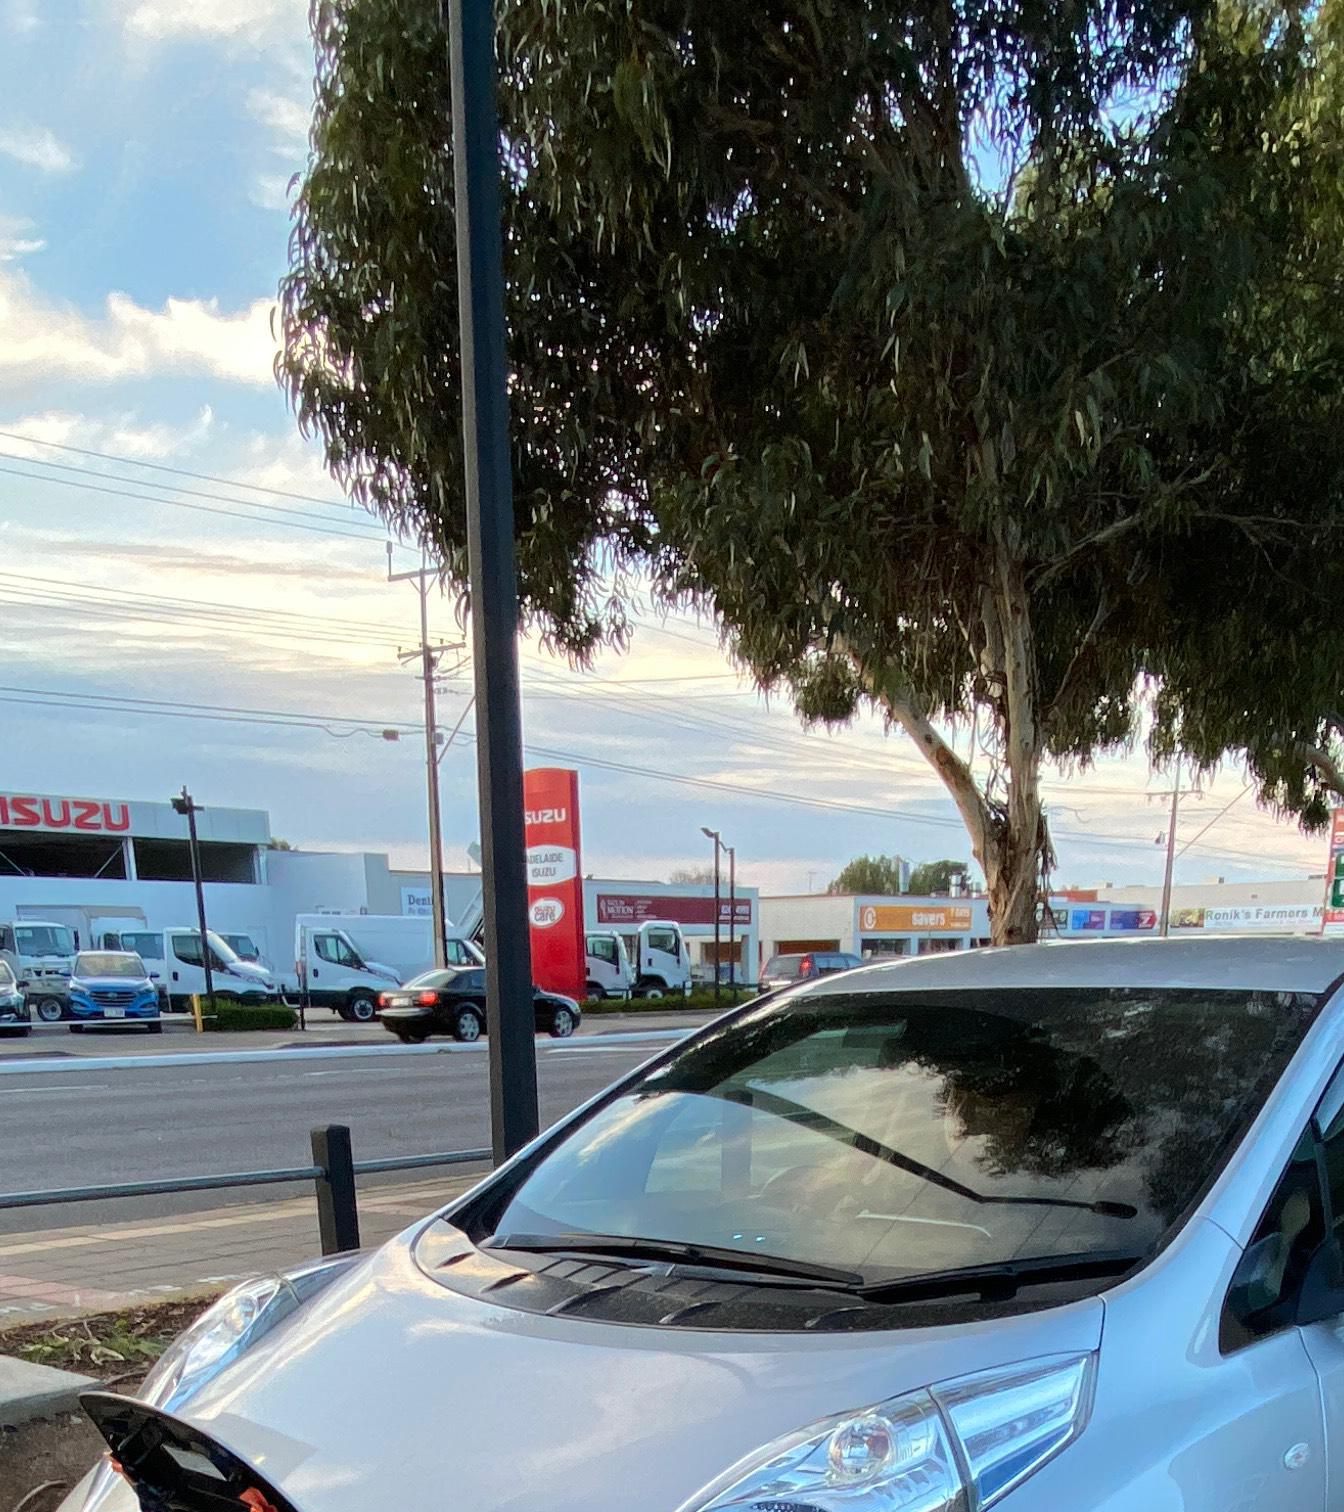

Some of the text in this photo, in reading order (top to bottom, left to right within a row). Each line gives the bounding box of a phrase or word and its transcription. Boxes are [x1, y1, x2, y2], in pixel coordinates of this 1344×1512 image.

[525, 808, 566, 825] SUZU
[531, 867, 557, 878] ISUZU
[1205, 909, 1251, 920] Ronik's
